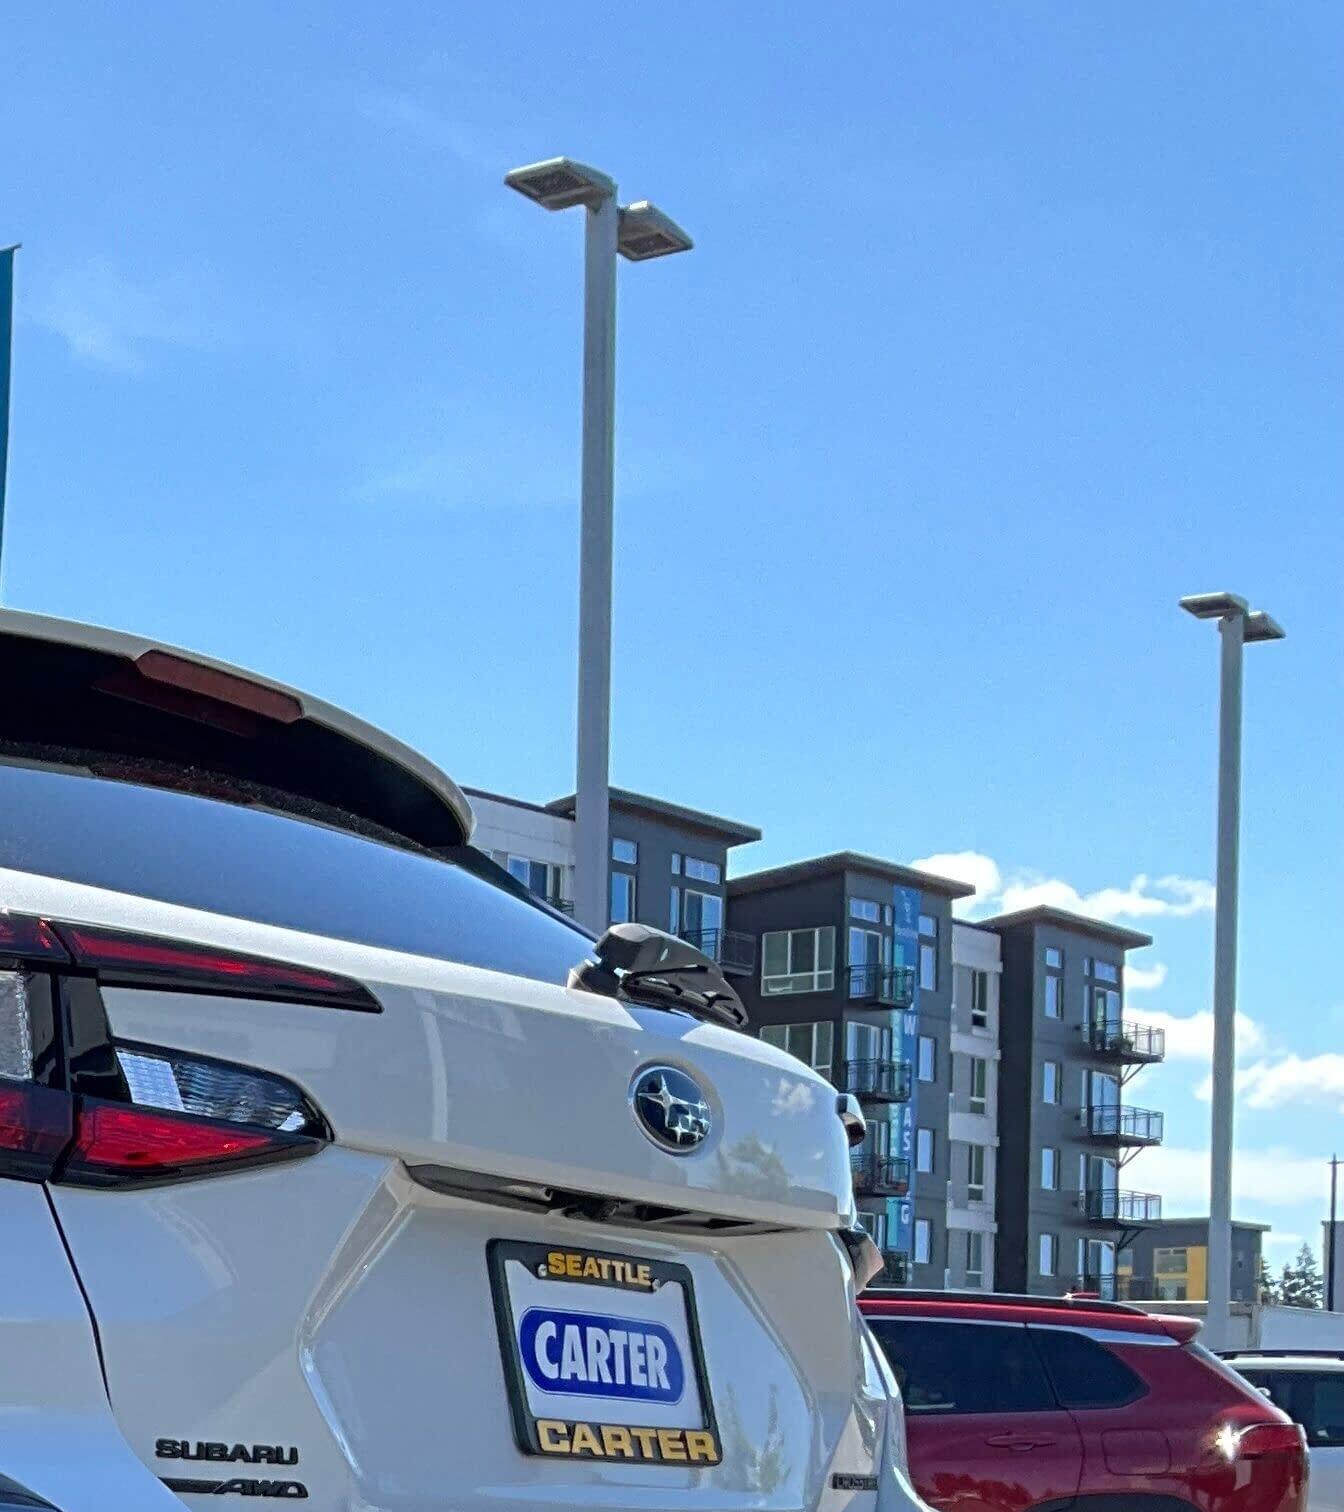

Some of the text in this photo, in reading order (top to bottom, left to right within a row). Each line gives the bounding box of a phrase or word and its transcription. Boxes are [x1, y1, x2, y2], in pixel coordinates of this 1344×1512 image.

[546, 1251, 652, 1286] SEATTLE
[534, 1320, 671, 1390] CARTER
[155, 1438, 299, 1465] SUBARU
[536, 1418, 718, 1462] CARTER
[213, 1478, 309, 1499] AWD
